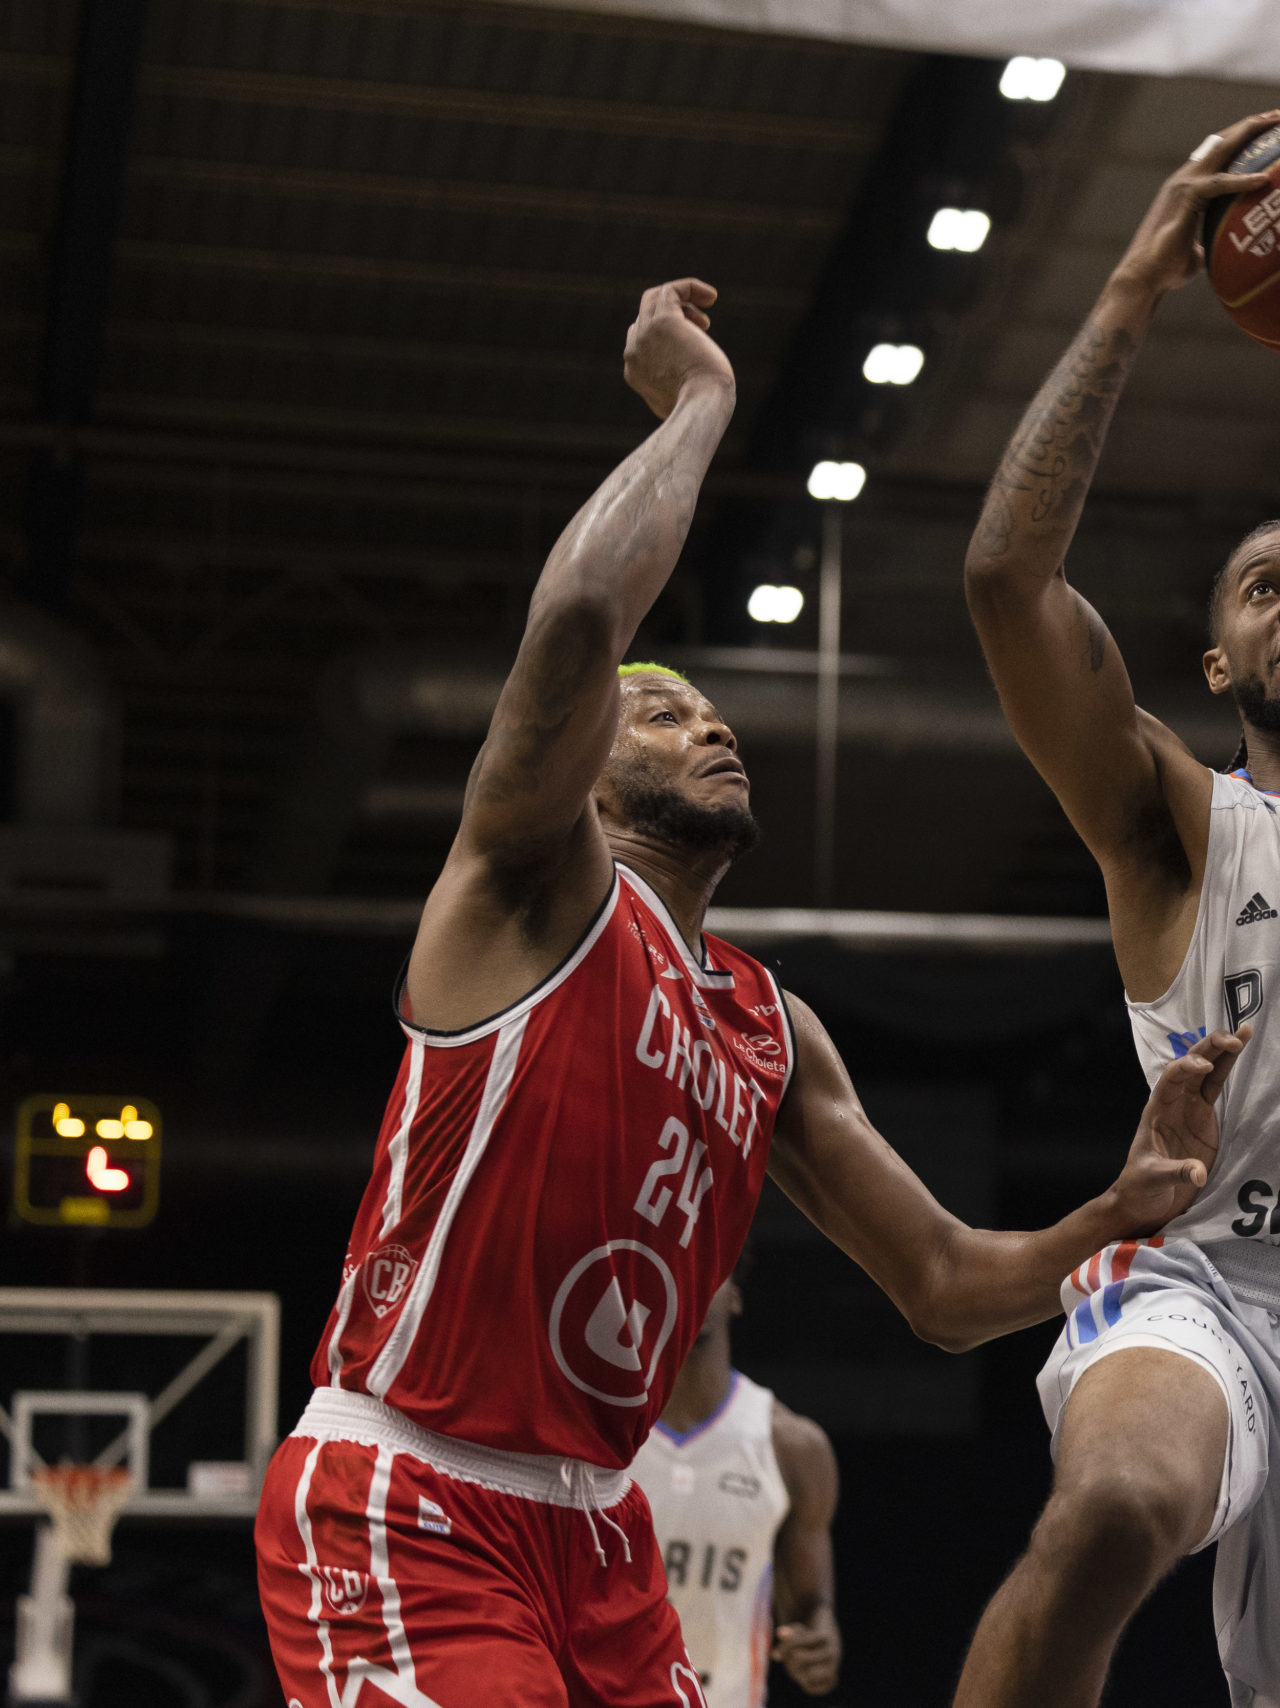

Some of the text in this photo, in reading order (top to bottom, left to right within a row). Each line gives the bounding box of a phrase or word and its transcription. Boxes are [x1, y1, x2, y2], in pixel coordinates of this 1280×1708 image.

[1236, 909, 1278, 926] adidas
[635, 984, 767, 1160] CHOLET
[633, 1115, 713, 1248] 24
[371, 1259, 410, 1302] CB
